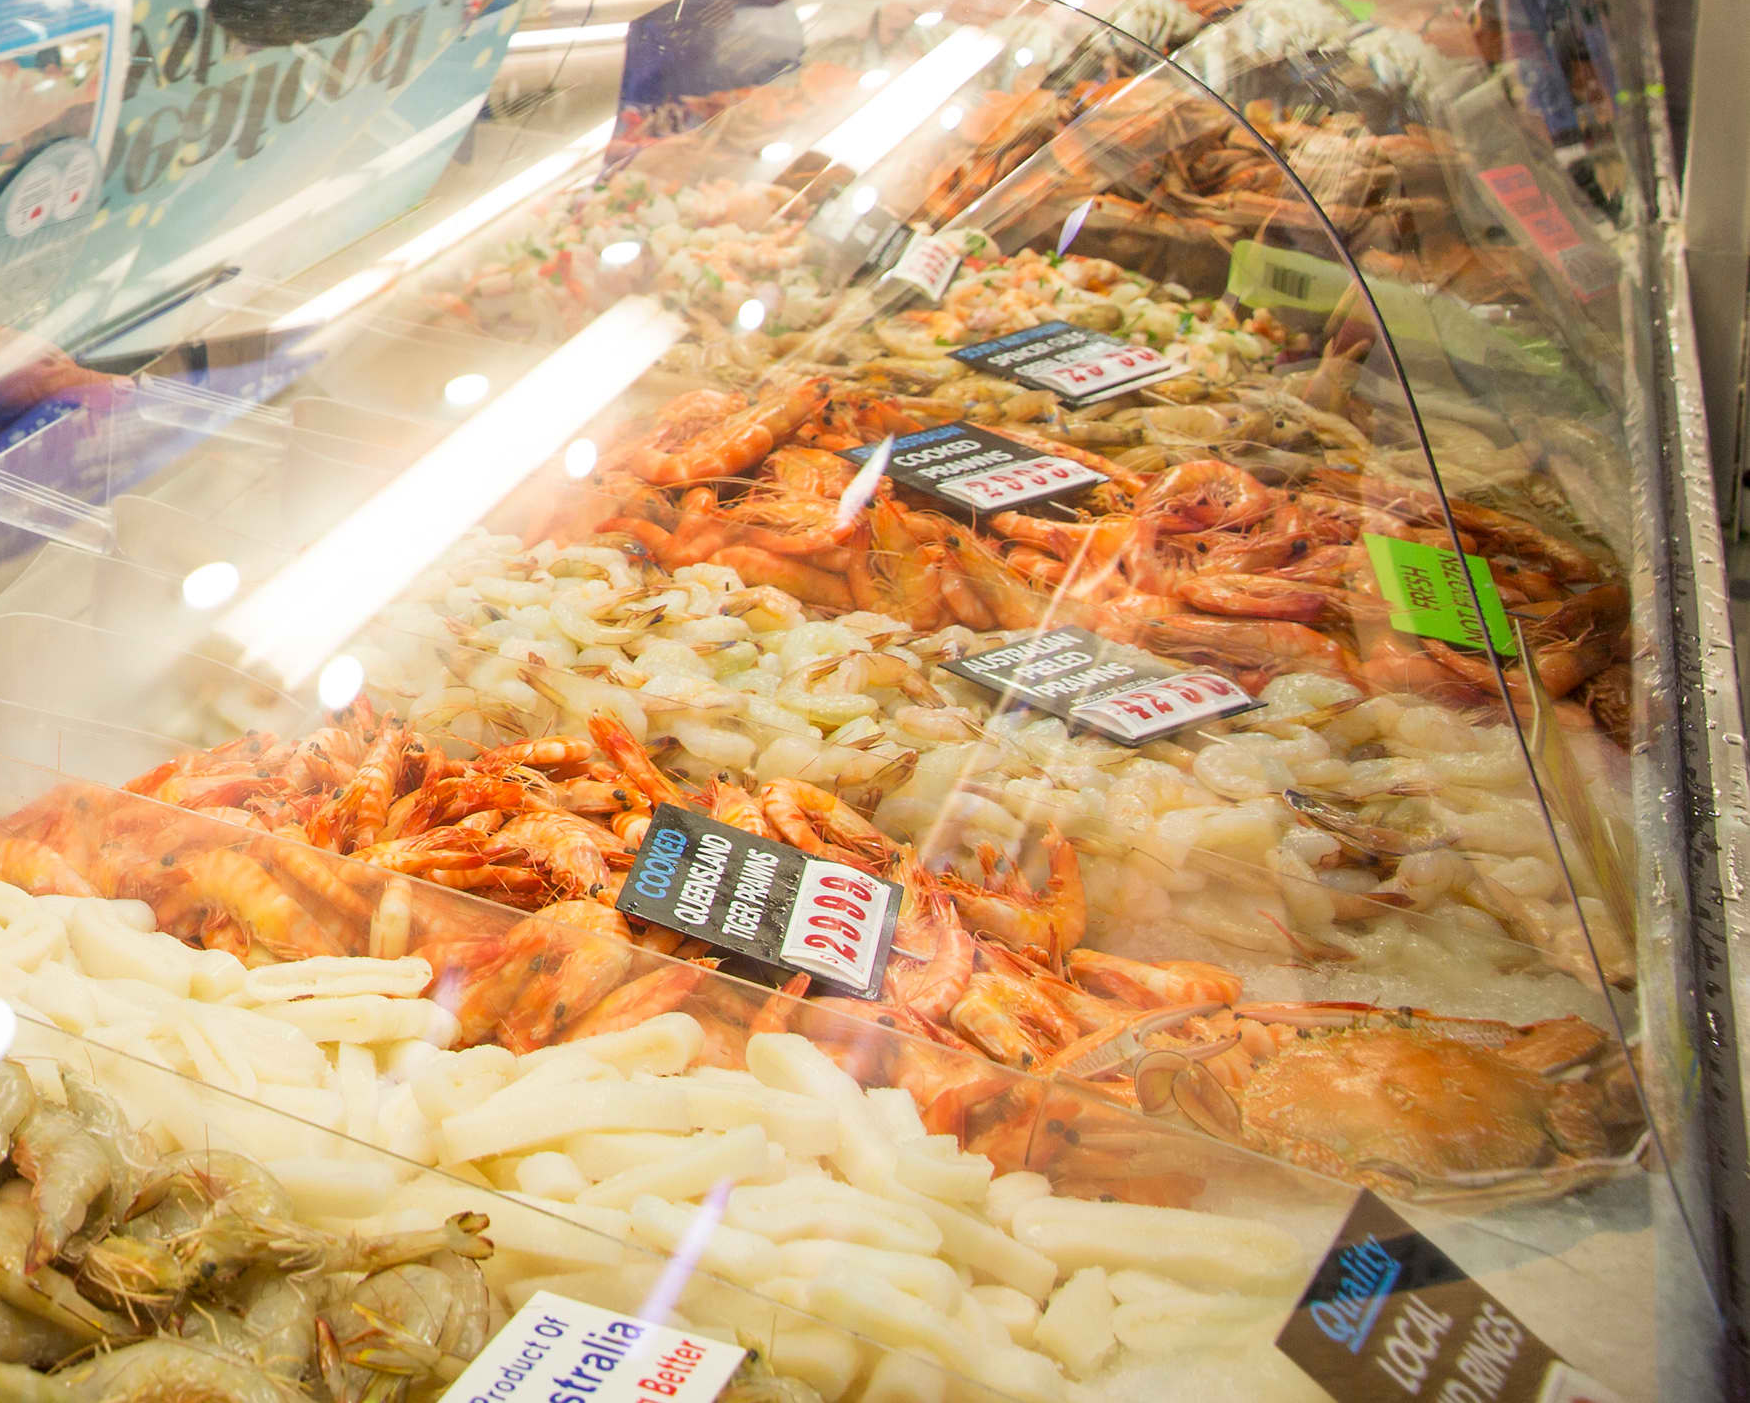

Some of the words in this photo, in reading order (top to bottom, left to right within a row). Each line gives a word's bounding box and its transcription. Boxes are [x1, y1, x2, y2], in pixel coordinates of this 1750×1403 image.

[892, 439, 982, 468] COOKED
[917, 449, 1014, 480] PRAWNS
[1399, 564, 1443, 612] FRESH
[1457, 607, 1486, 644] NOT
[961, 632, 1083, 675] AUSTRALIAN
[1013, 650, 1094, 681] PEELED
[1033, 661, 1135, 698] PRAWNS
[634, 828, 688, 899] COOKED
[673, 833, 732, 925] QUEENSLAND
[734, 848, 779, 907] PRAWNS
[722, 899, 764, 941] TIGER
[1309, 1231, 1402, 1344] Quality
[637, 1338, 707, 1397] Better
[1375, 1292, 1453, 1395] LOCAL
[1455, 1301, 1524, 1400] RINGS
